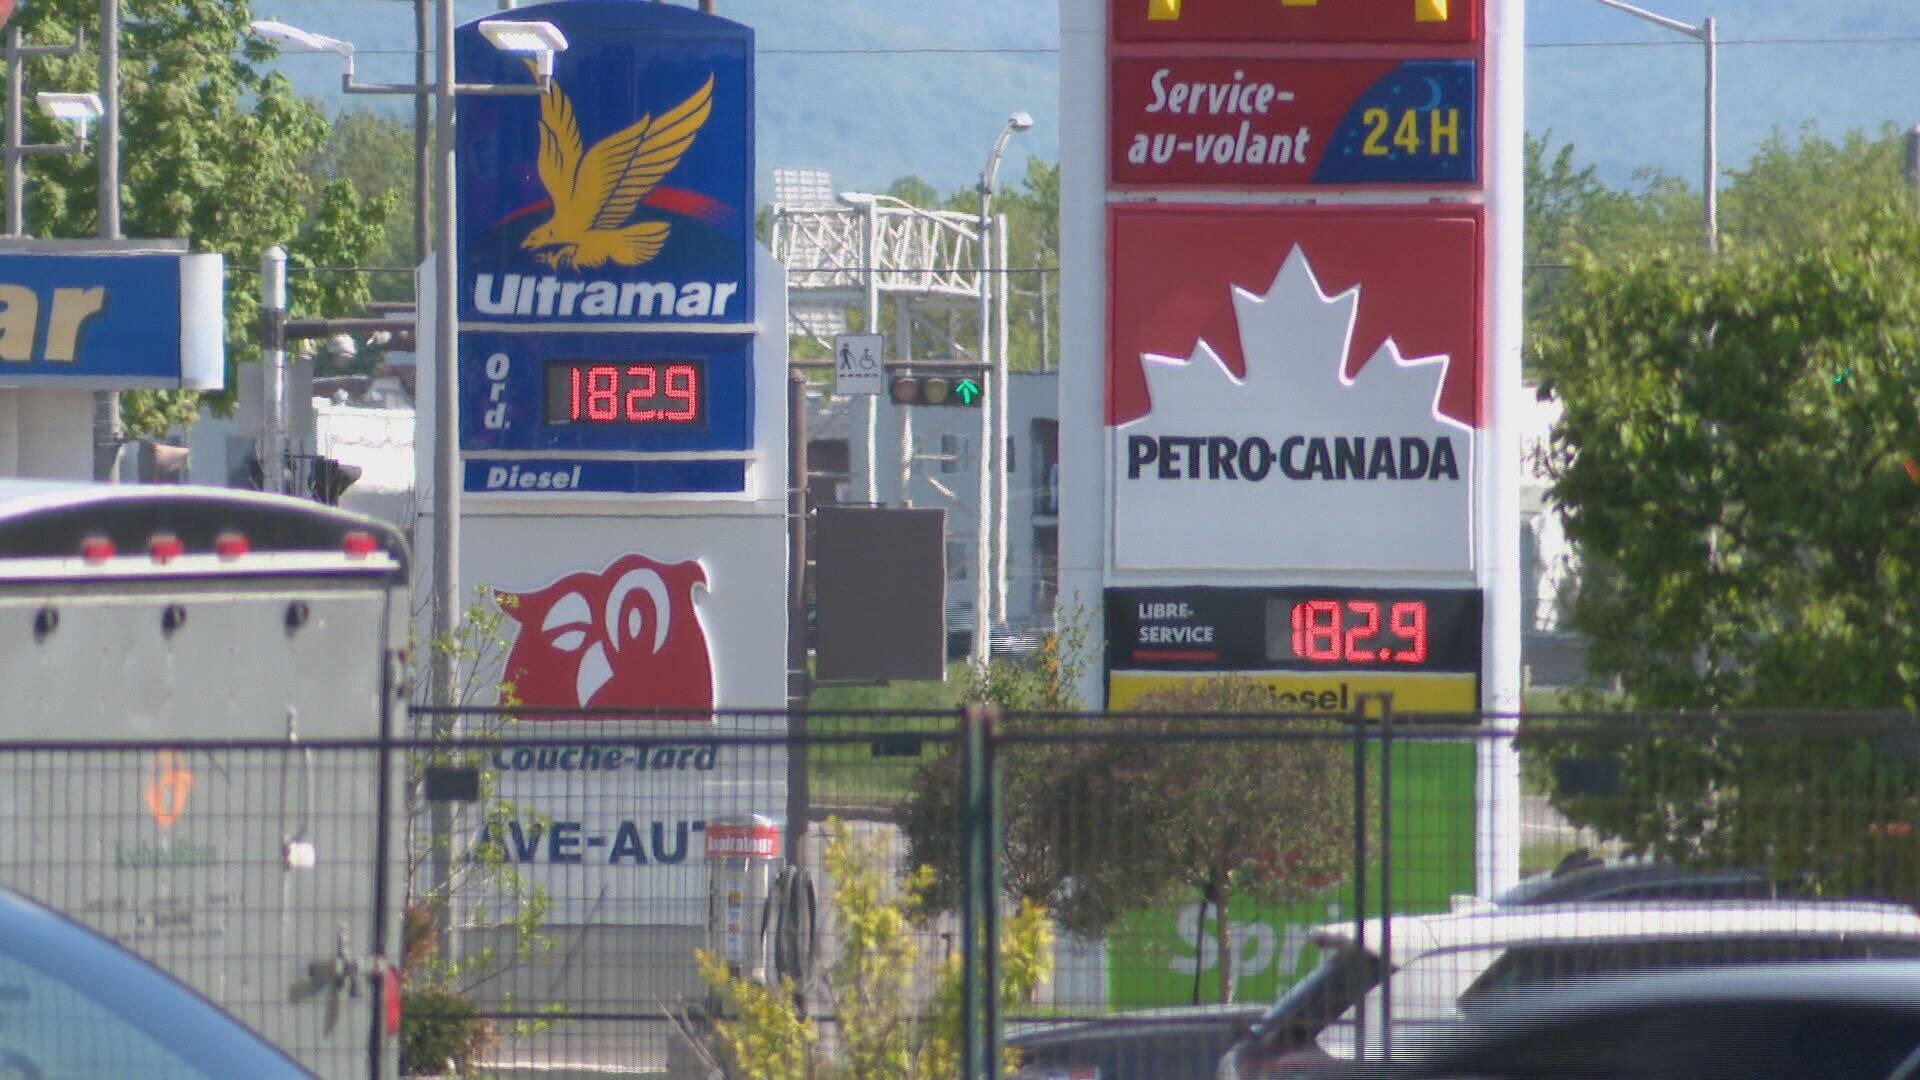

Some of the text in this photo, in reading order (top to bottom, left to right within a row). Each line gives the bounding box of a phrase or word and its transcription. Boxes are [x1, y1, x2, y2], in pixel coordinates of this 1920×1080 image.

[1145, 67, 1295, 115] Service-
[1127, 120, 1312, 165] au-volant
[475, 273, 738, 316] Ultramar
[570, 363, 699, 423] 182.9
[486, 464, 583, 489] Diesel
[1137, 602, 1195, 620] LIBRE-
[1290, 598, 1427, 664] 182.9
[1138, 626, 1216, 643] SERVICE
